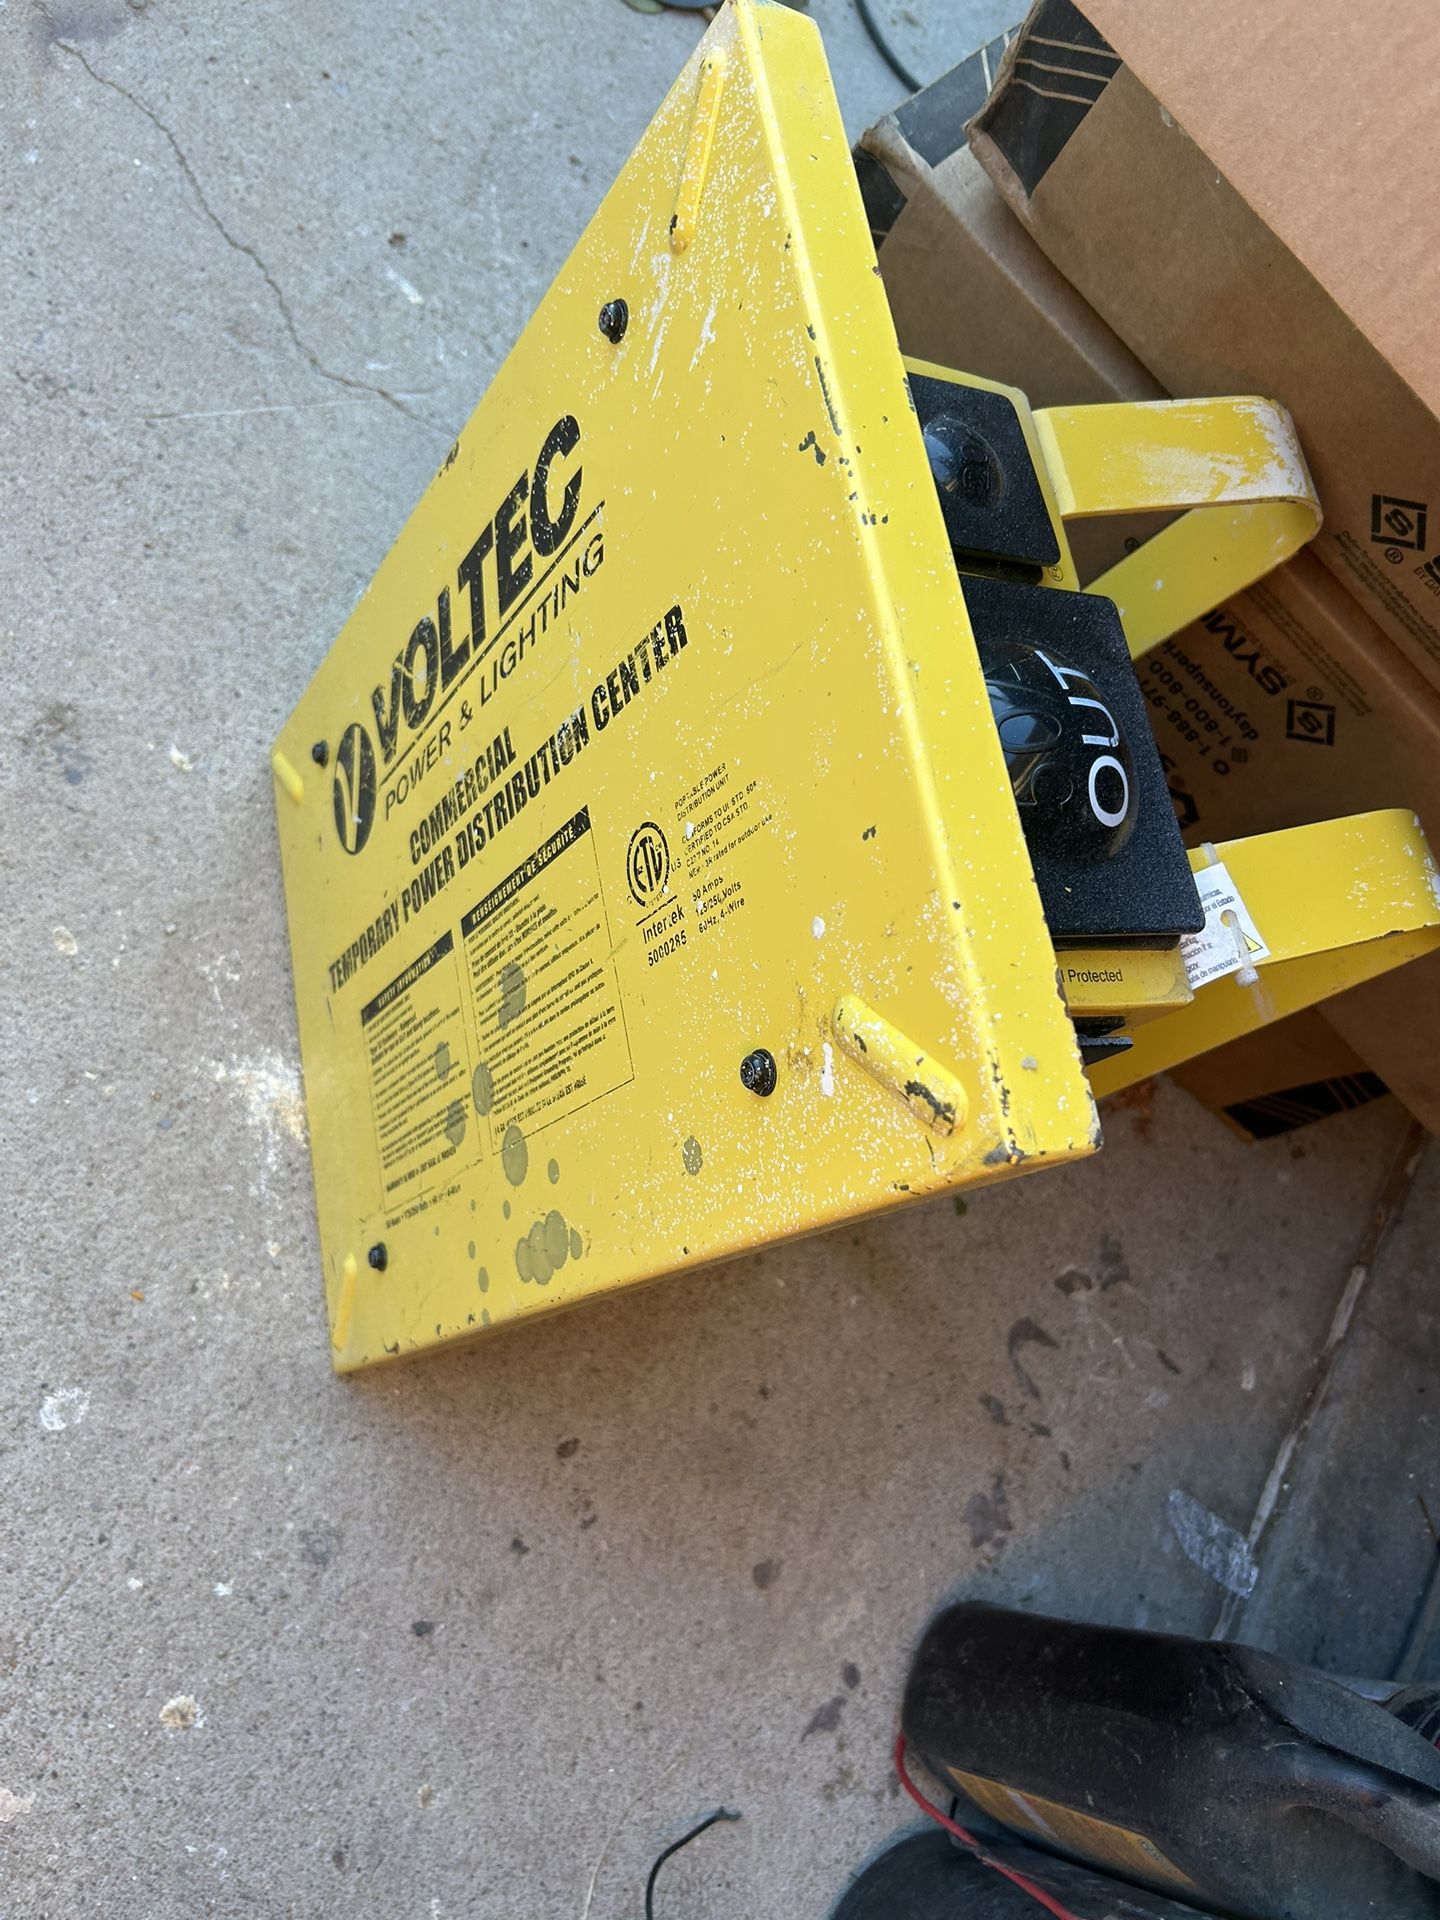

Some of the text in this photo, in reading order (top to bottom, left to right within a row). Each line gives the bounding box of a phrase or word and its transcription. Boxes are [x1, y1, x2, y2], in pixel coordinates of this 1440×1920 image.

[371, 415, 583, 762] VOLTEC
[385, 533, 606, 821] POWER & LIGHTING
[1034, 650, 1129, 827] OUT
[704, 763, 727, 785] POWER
[329, 900, 400, 994] TEMPORARY
[402, 846, 457, 924] POWER
[457, 704, 592, 871] DISTRIBUTION
[592, 604, 689, 731] CENTER
[409, 726, 517, 865] COMMERCIAL
[677, 774, 729, 821] DISTRIBUTION UNIT
[713, 808, 723, 819] TO
[713, 822, 723, 832] TO
[713, 845, 728, 861] rated
[702, 876, 724, 896] Amps
[721, 881, 742, 899] Volts
[1067, 969, 1123, 983] Protected
